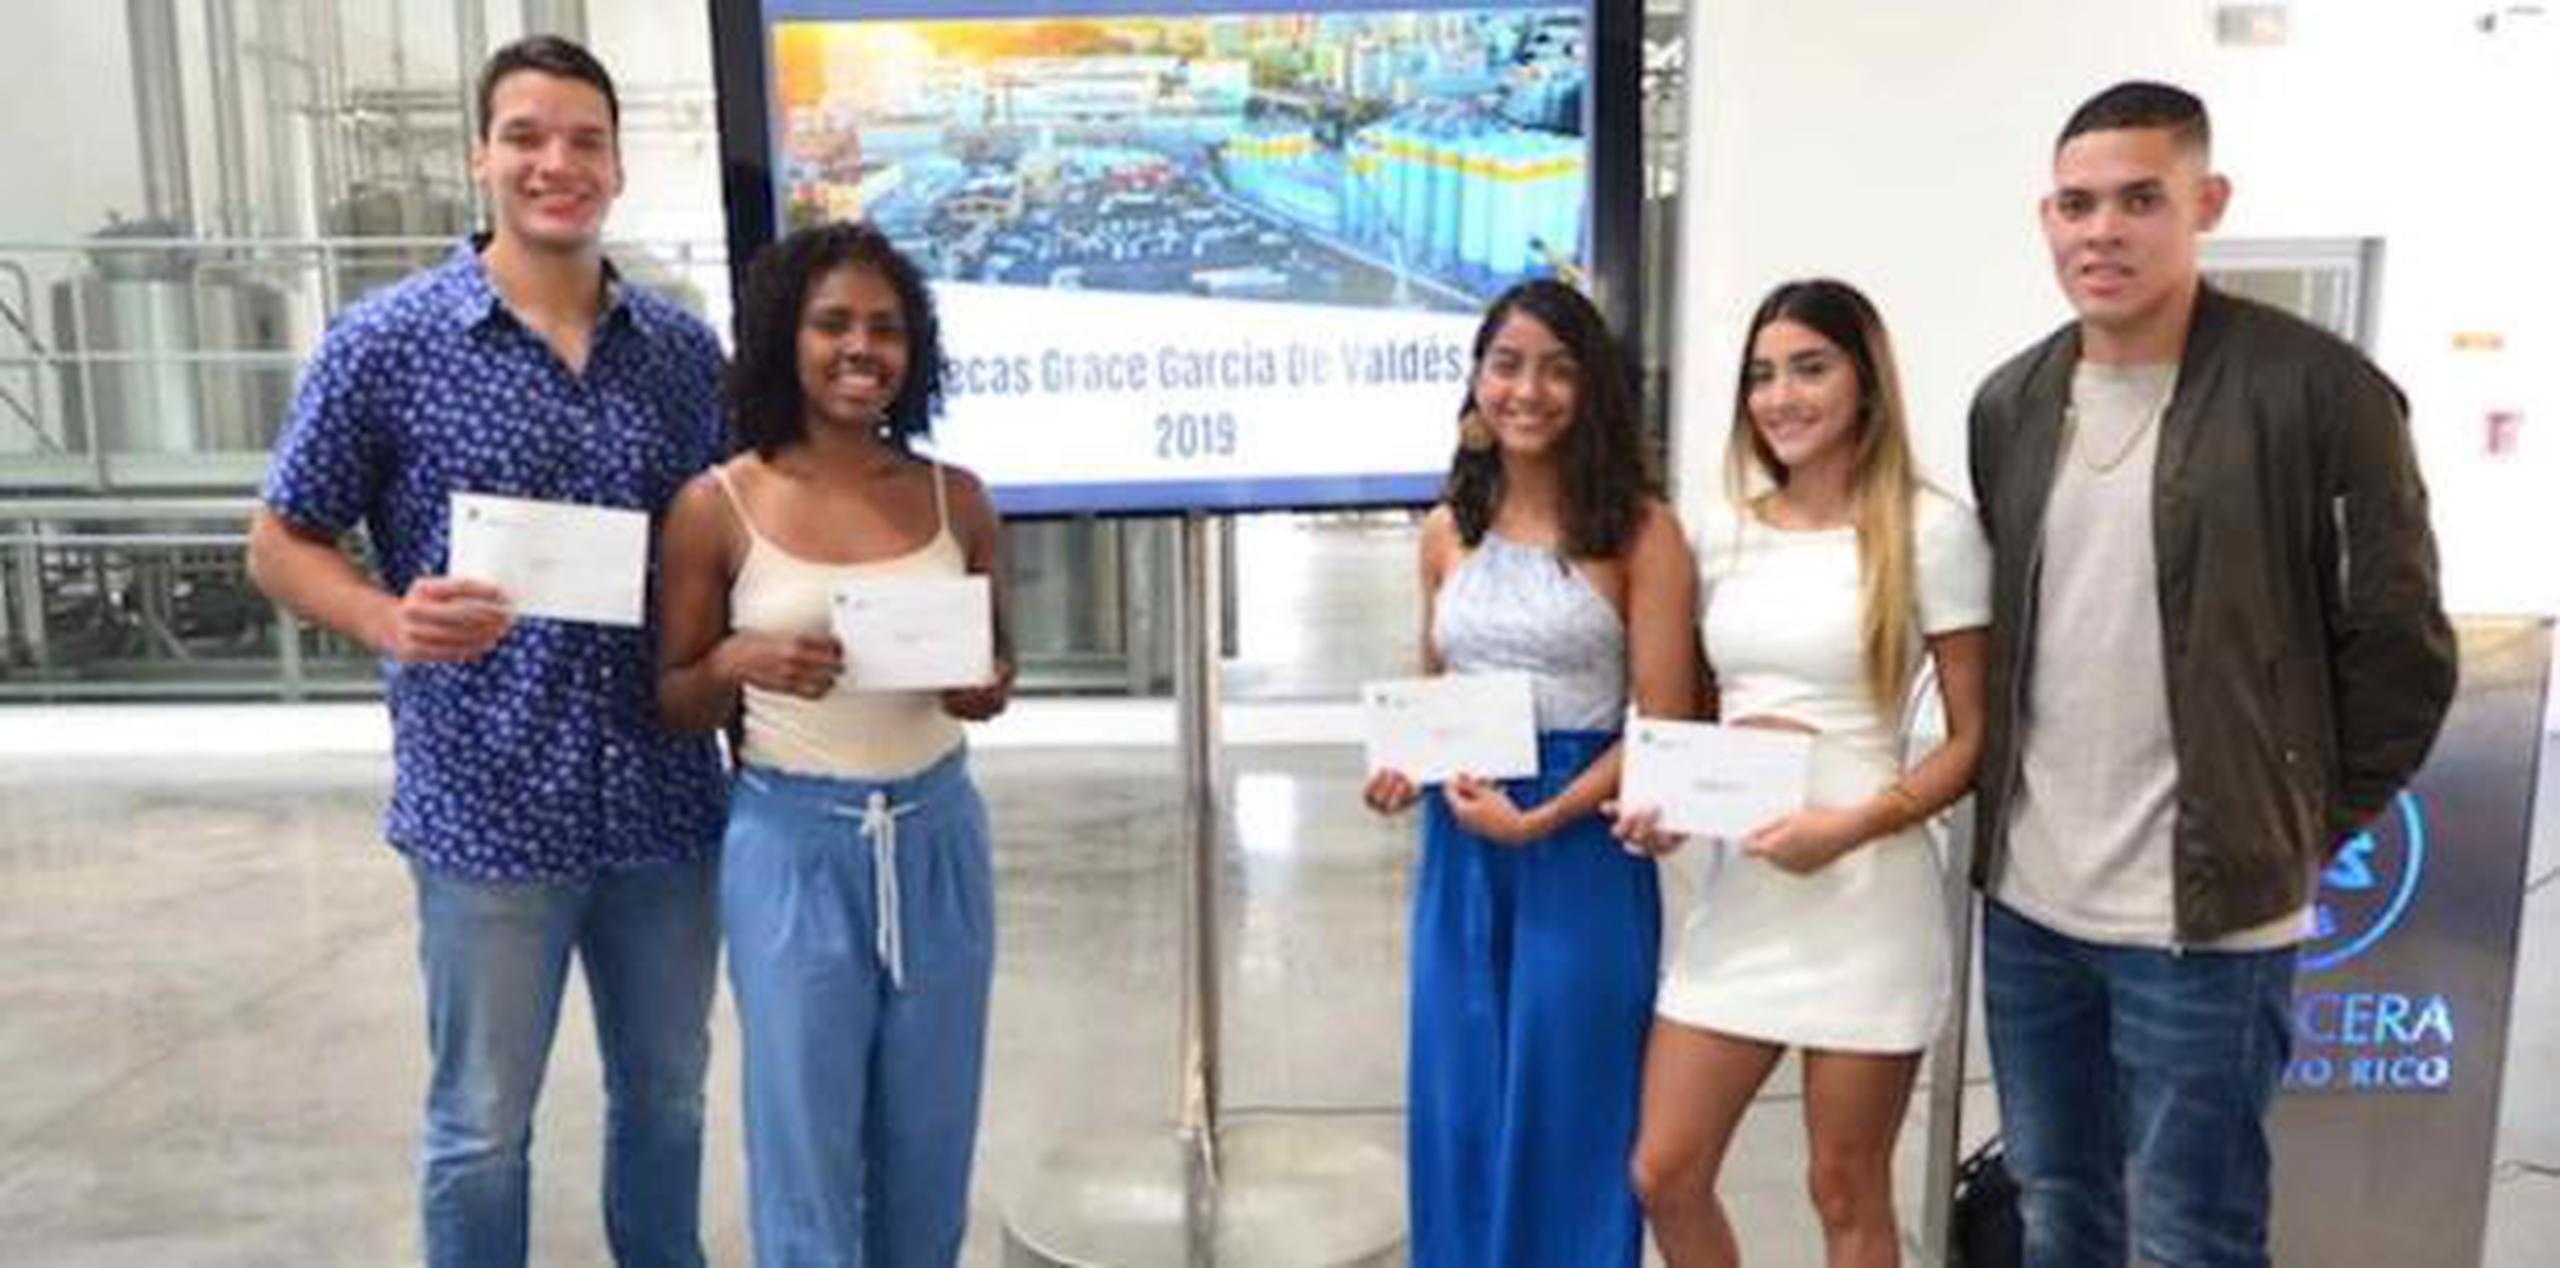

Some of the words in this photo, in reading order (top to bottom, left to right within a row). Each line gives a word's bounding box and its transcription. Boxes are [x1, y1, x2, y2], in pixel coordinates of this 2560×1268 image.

[940, 355, 1032, 396] ecas
[1041, 347, 1147, 394] Grace
[1338, 332, 1463, 385] Valdés
[1155, 412, 1237, 459] 2019
[2298, 993, 2453, 1045] CERA
[2350, 1055, 2449, 1087] RICO
